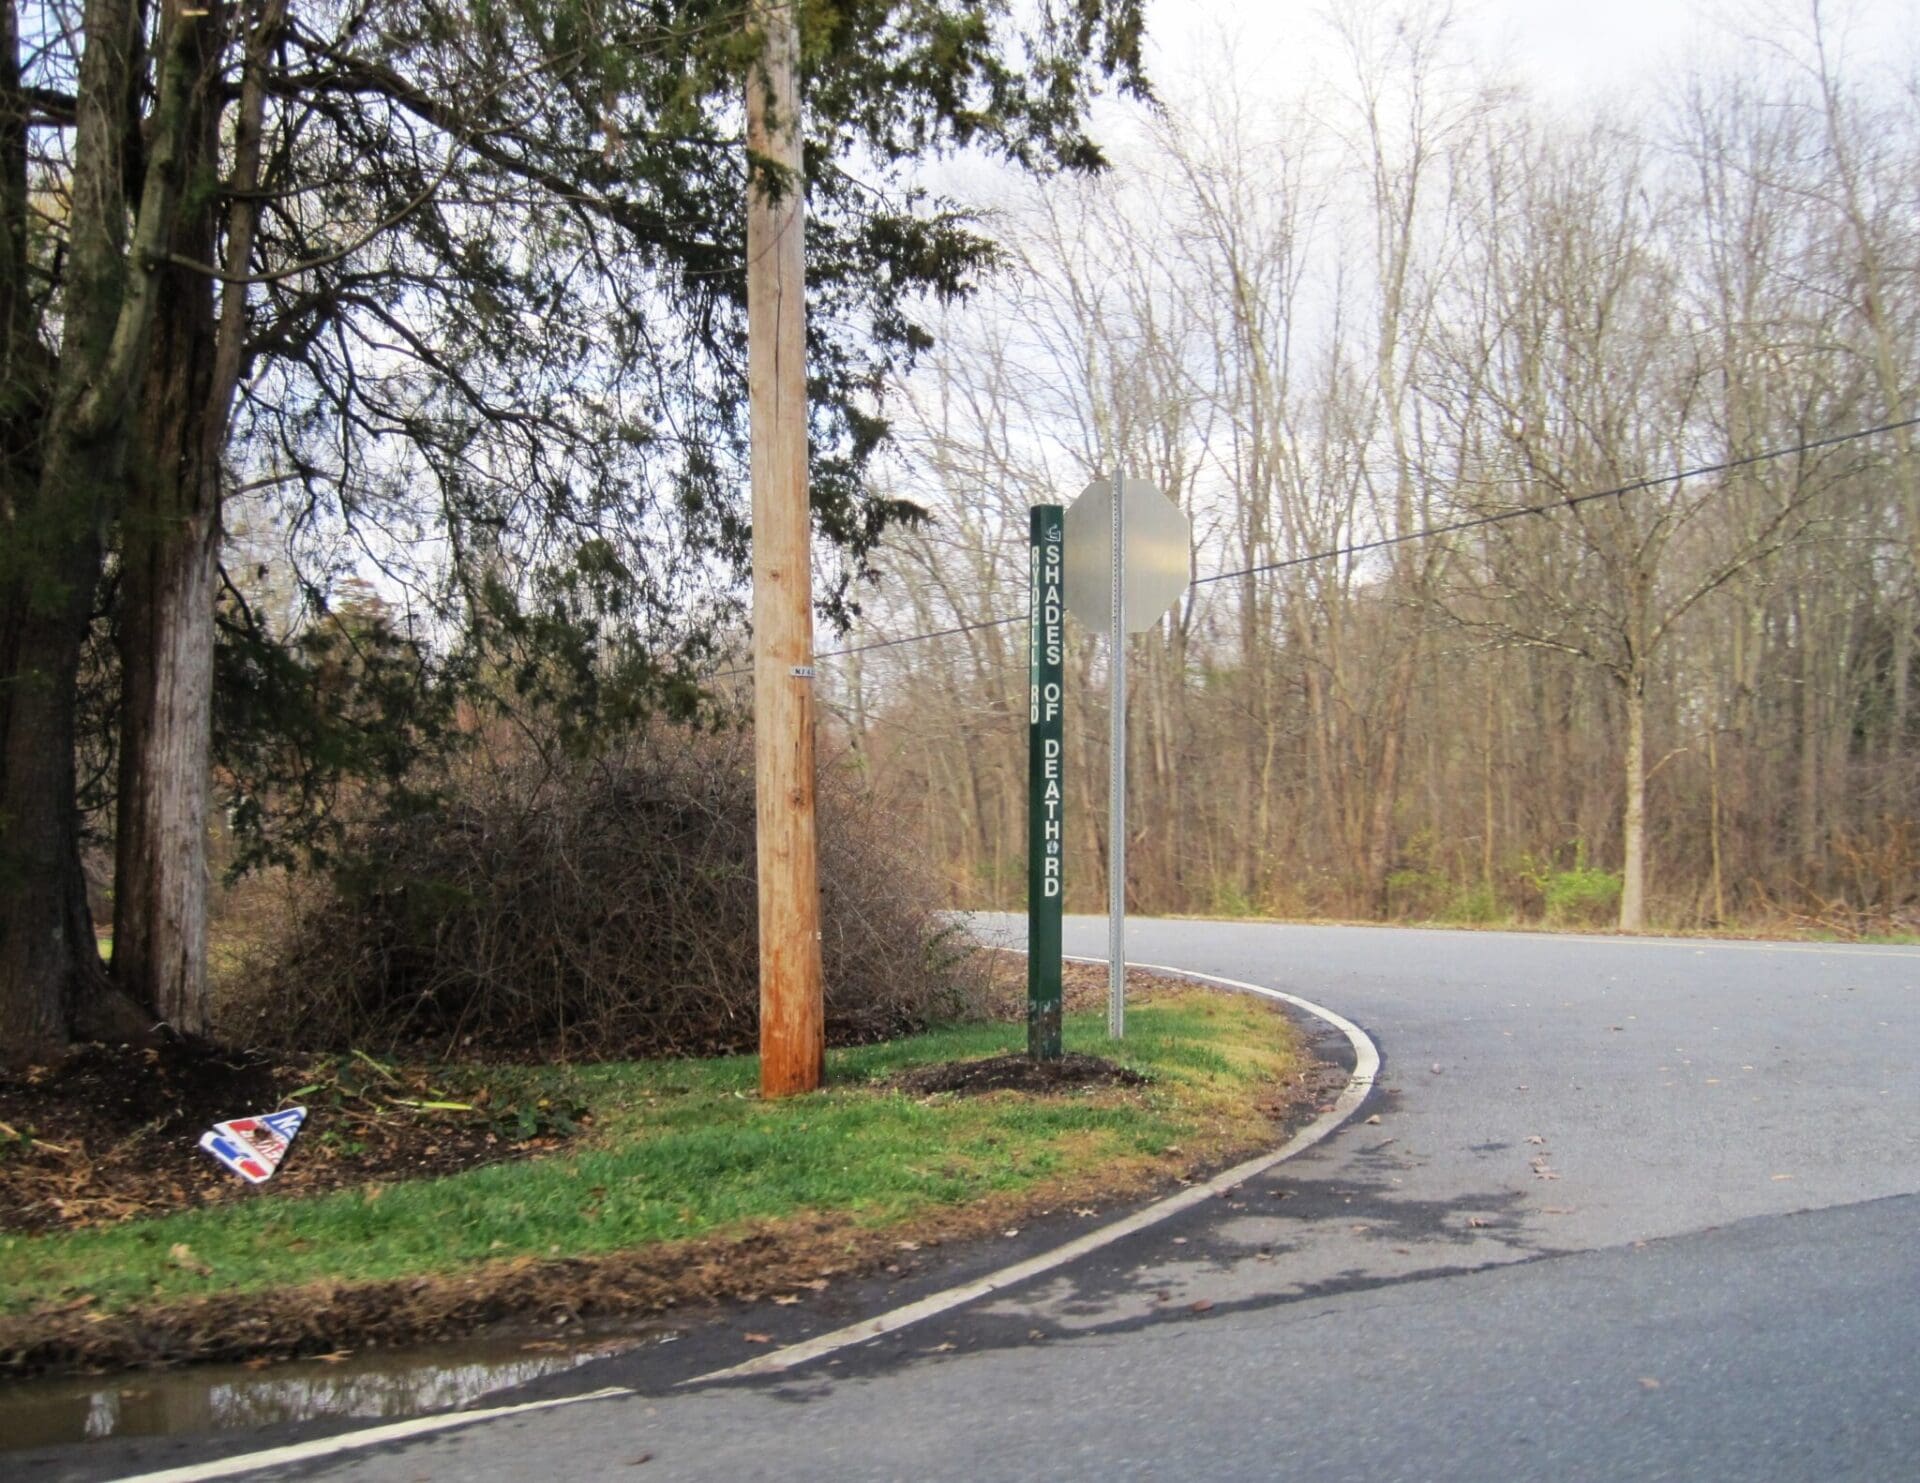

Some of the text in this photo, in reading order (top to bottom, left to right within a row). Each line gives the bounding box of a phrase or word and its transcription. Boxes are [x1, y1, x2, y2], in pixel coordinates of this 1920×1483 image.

[1031, 546, 1040, 724] RYDELL RD
[1044, 545, 1060, 897] SHADES OF DEATH RD
